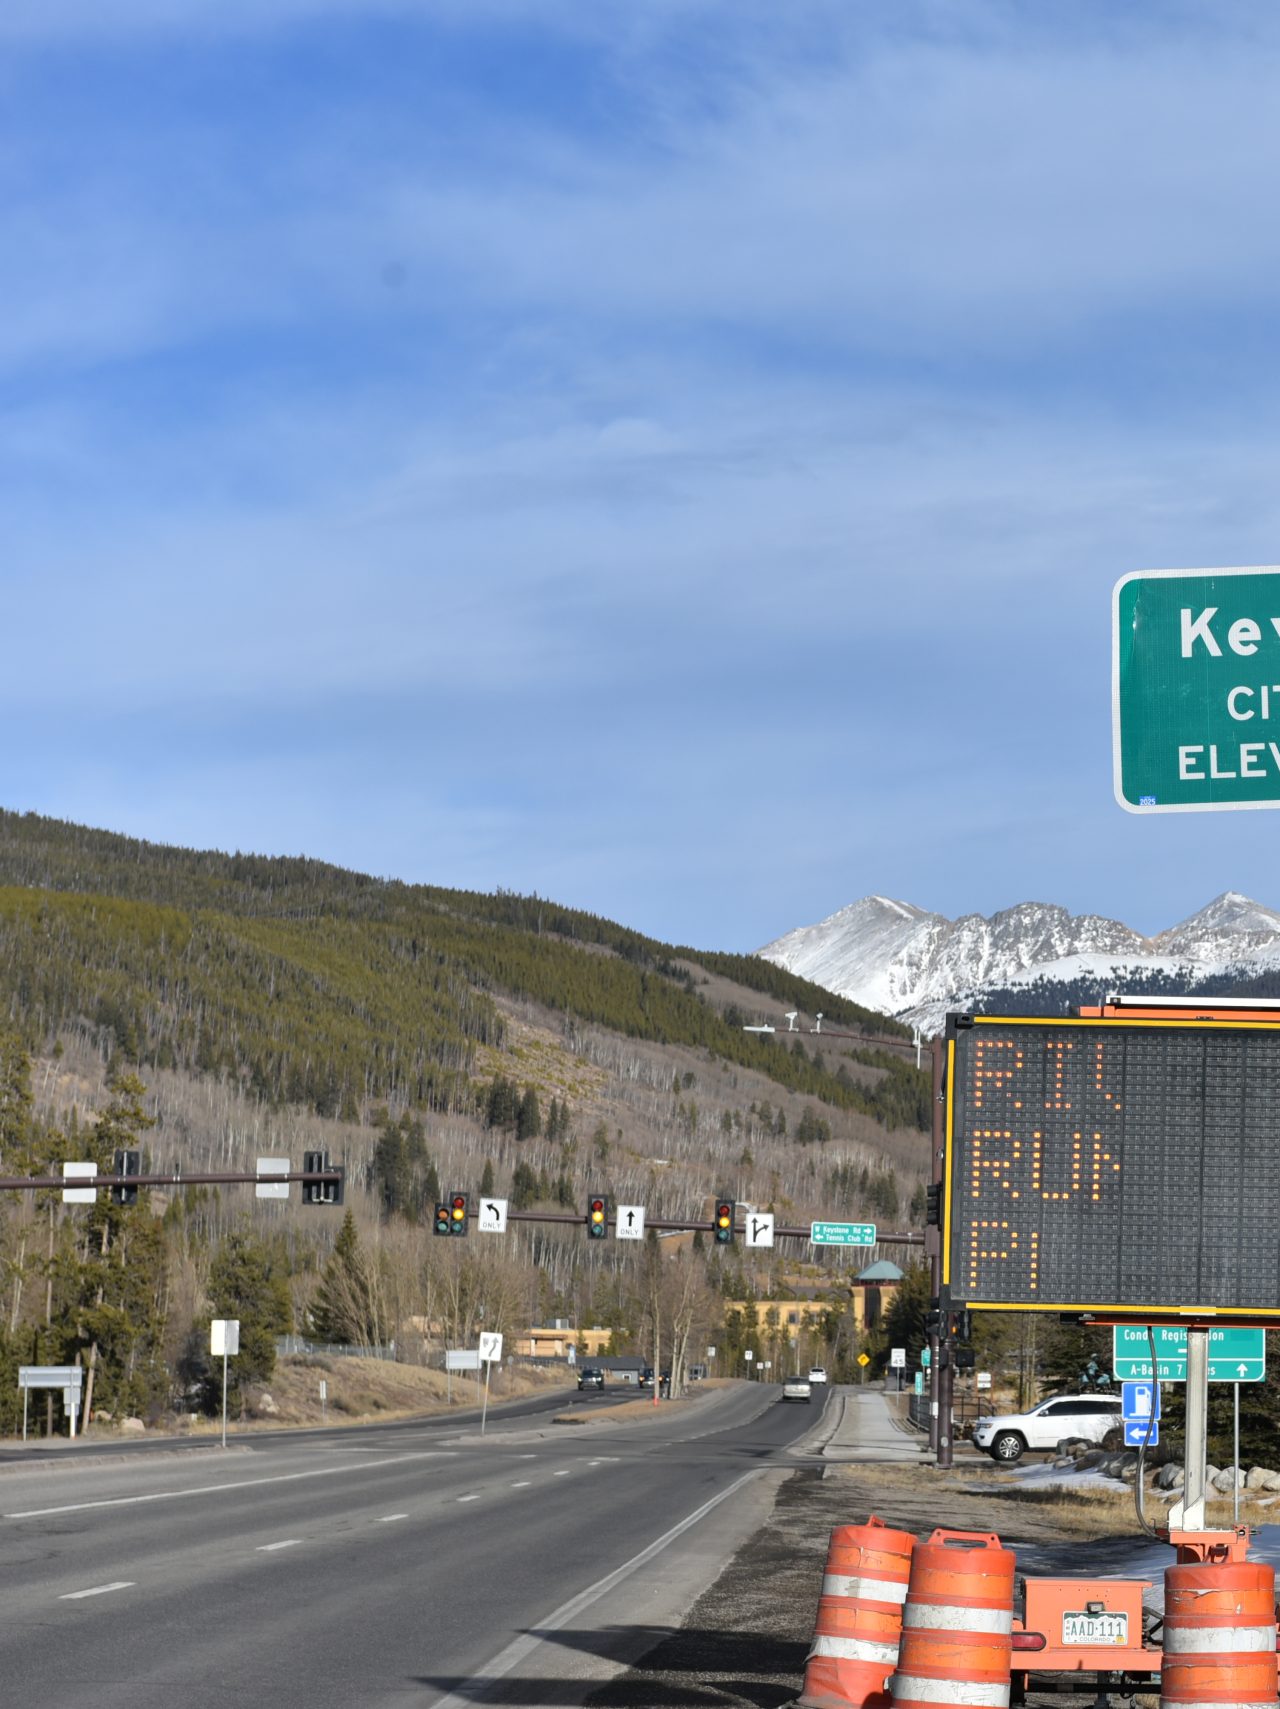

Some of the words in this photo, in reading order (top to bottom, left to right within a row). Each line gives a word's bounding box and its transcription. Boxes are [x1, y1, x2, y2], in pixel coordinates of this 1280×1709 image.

[482, 1221, 501, 1230] ONLY
[823, 1226, 849, 1234] Keystone
[620, 1228, 639, 1236] ONLY
[1161, 1329, 1224, 1344] Regision
[1130, 1364, 1169, 1376] A-Bain
[1176, 1363, 1183, 1376] 7
